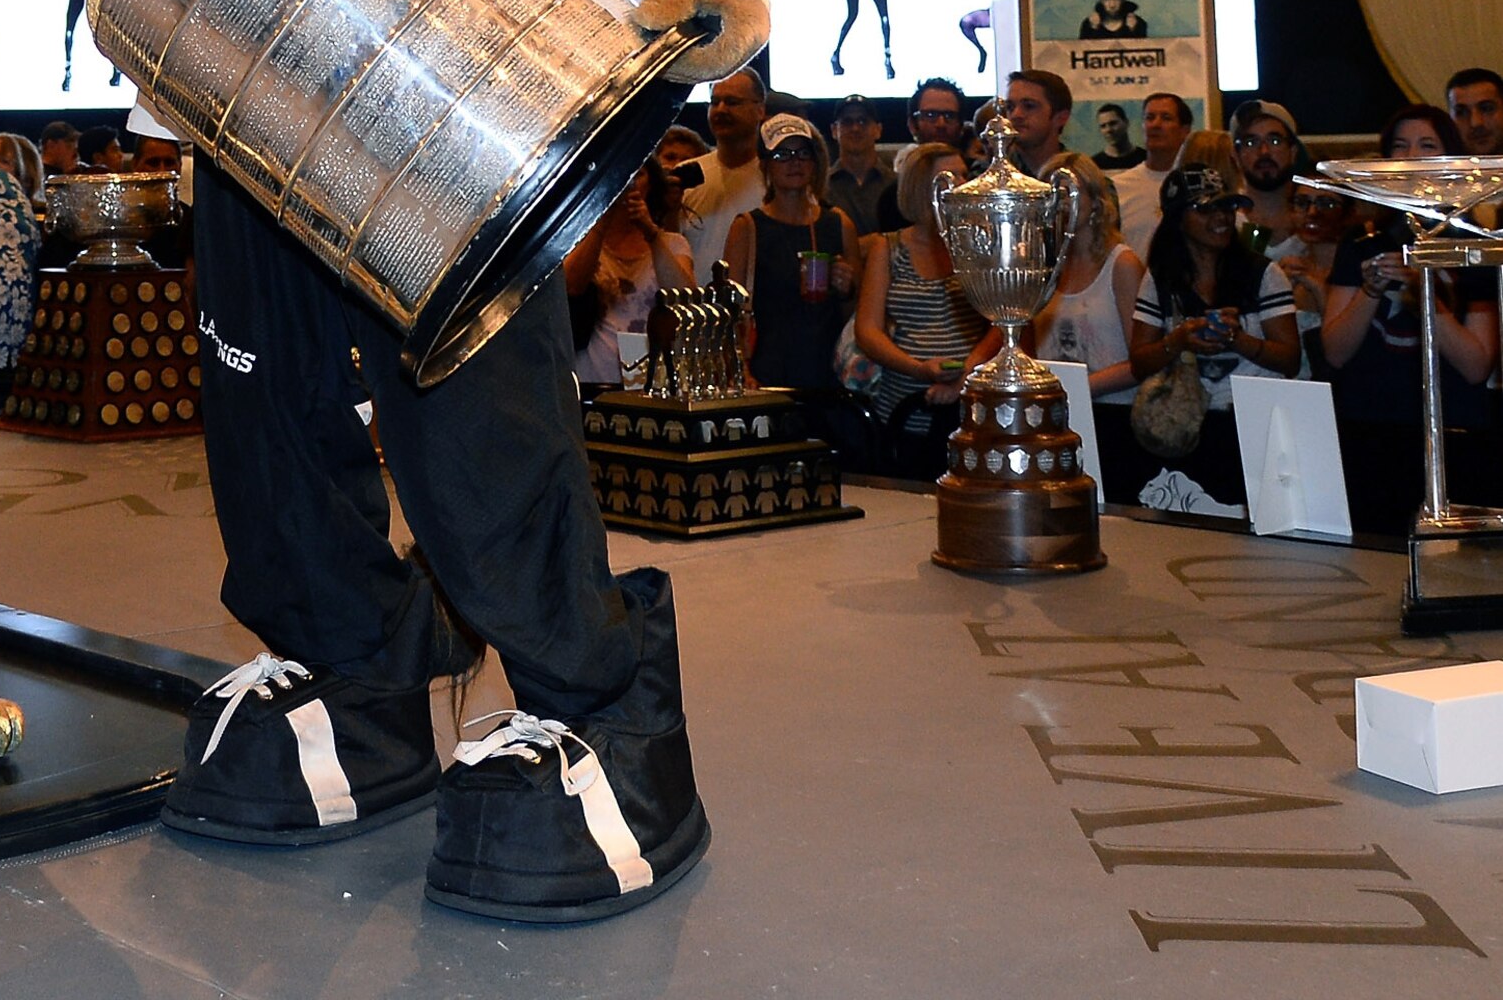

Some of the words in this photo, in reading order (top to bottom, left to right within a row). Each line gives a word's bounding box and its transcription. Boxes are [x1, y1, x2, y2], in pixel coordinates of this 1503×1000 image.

[1070, 48, 1166, 70] Hardwell
[1113, 76, 1135, 86] JUN
[963, 621, 1240, 701] AT
[1020, 722, 1488, 958] LIVE
